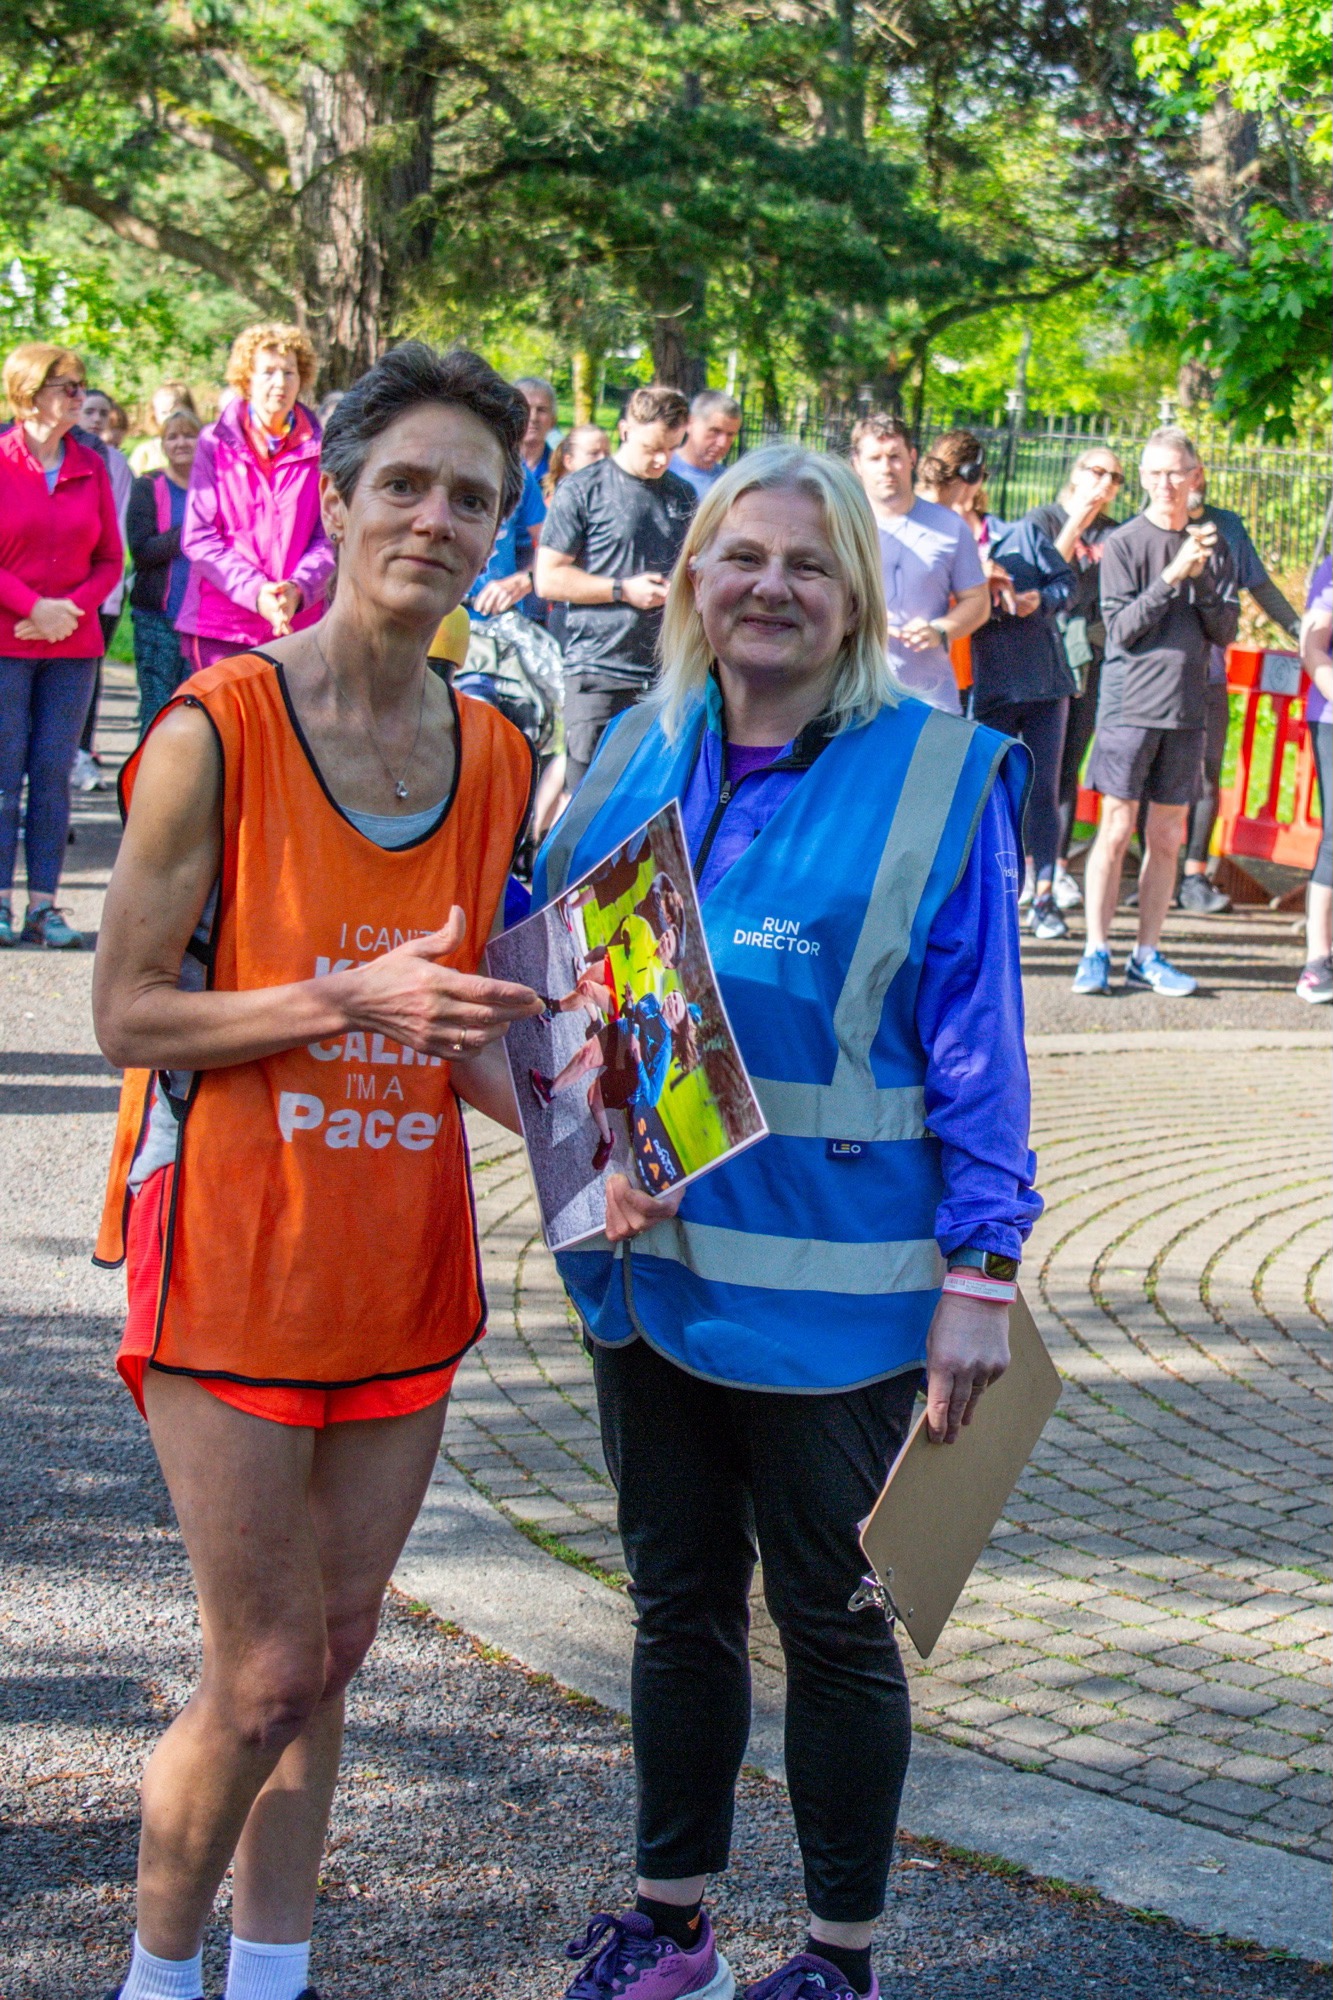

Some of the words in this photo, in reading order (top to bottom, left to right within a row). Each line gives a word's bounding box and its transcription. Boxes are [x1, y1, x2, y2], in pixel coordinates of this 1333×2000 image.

[340, 923, 347, 949] I
[762, 917, 800, 936] RUN
[733, 929, 820, 957] DIRECTOR
[346, 1074, 376, 1101] I'M
[383, 1075, 404, 1101] A
[832, 1143, 861, 1154] LEO
